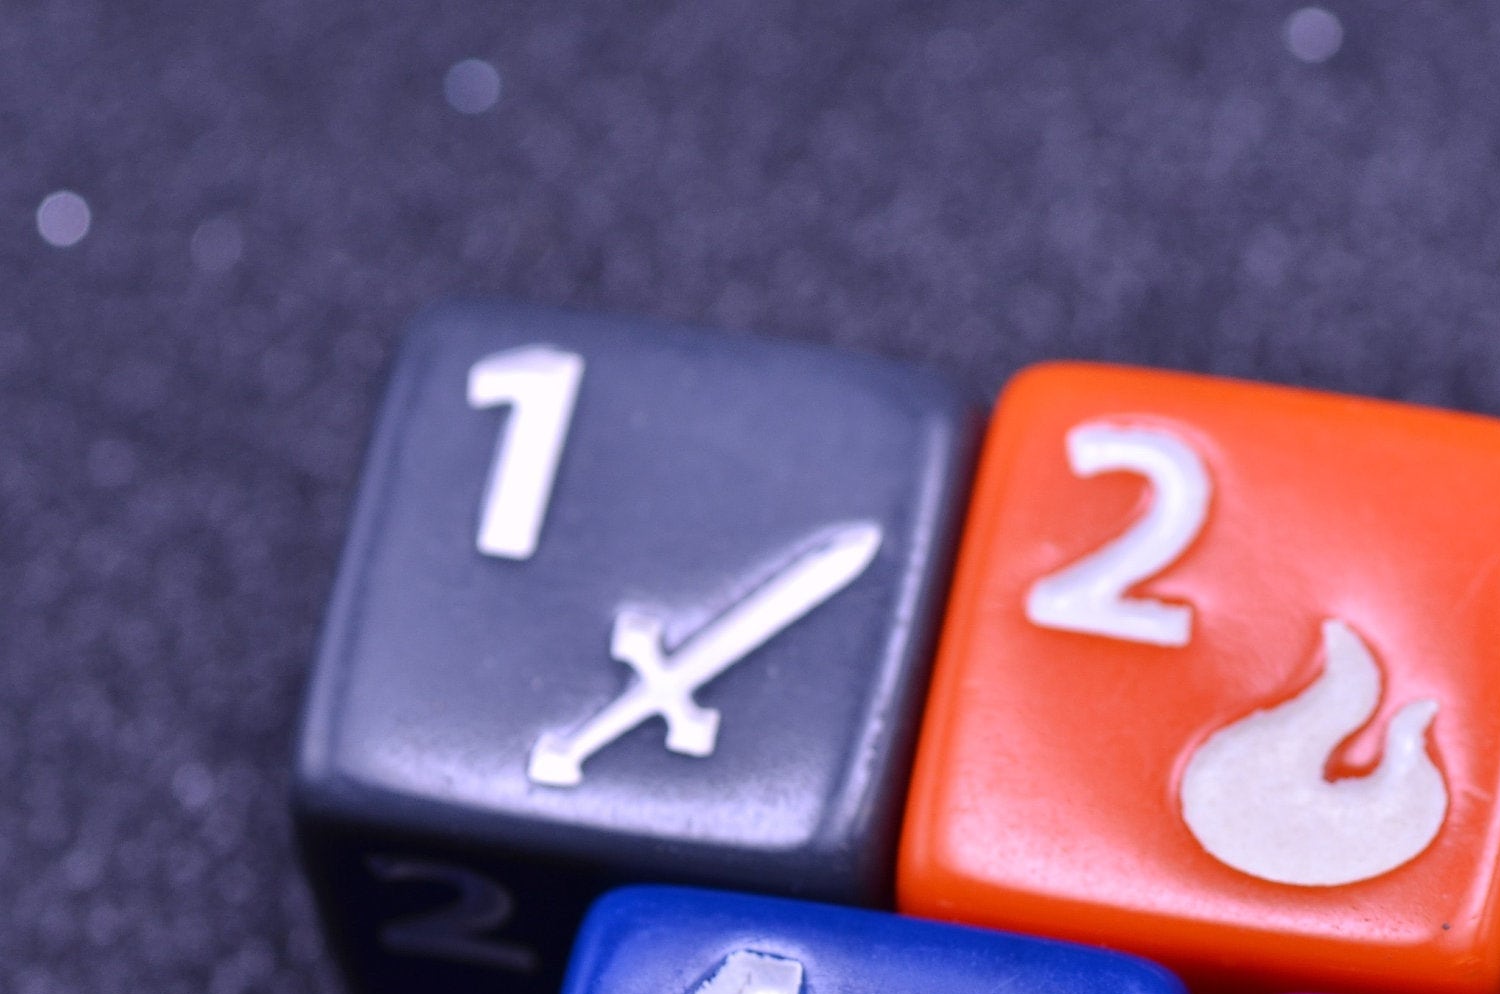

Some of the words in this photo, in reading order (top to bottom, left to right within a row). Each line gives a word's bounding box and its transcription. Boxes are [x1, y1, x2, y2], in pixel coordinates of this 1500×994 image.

[467, 346, 585, 559] 1
[1025, 425, 1213, 647] 2
[367, 854, 541, 972] 2
